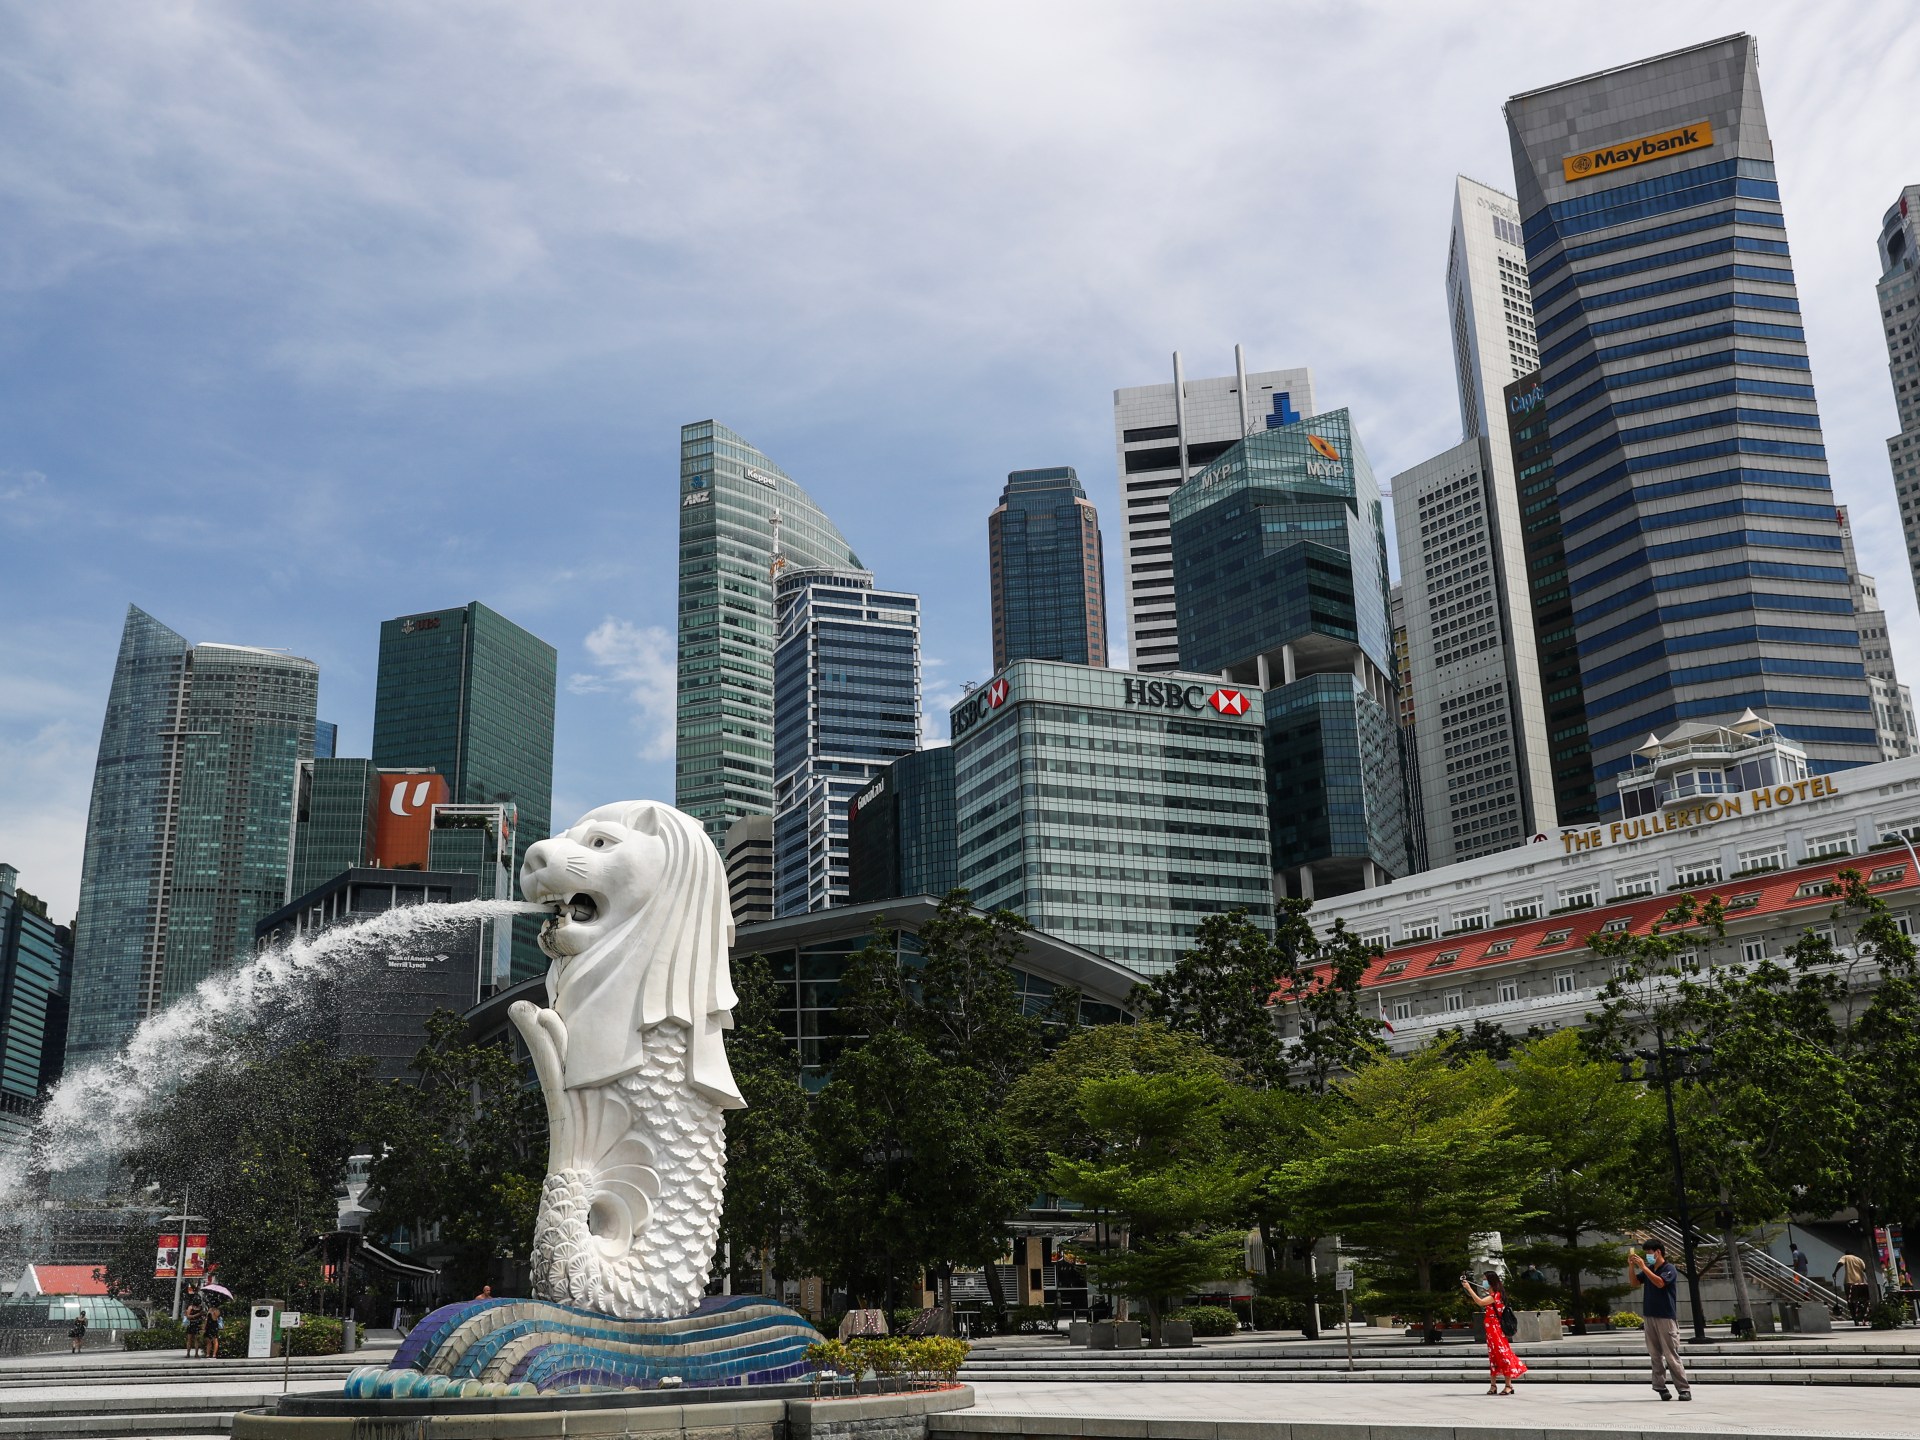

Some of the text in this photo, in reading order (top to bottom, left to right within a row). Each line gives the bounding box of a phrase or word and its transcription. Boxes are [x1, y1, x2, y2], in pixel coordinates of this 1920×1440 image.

[1595, 130, 1699, 168] Maybank
[748, 468, 776, 487] Keppel
[1202, 464, 1231, 490] MYP
[1307, 461, 1344, 478] MYP
[683, 491, 710, 507] ANZ
[416, 617, 440, 630] UBS
[1123, 678, 1206, 711] HSBC
[950, 690, 988, 739] HSBC
[1560, 775, 1838, 853] THE FULLERTON HOTEL
